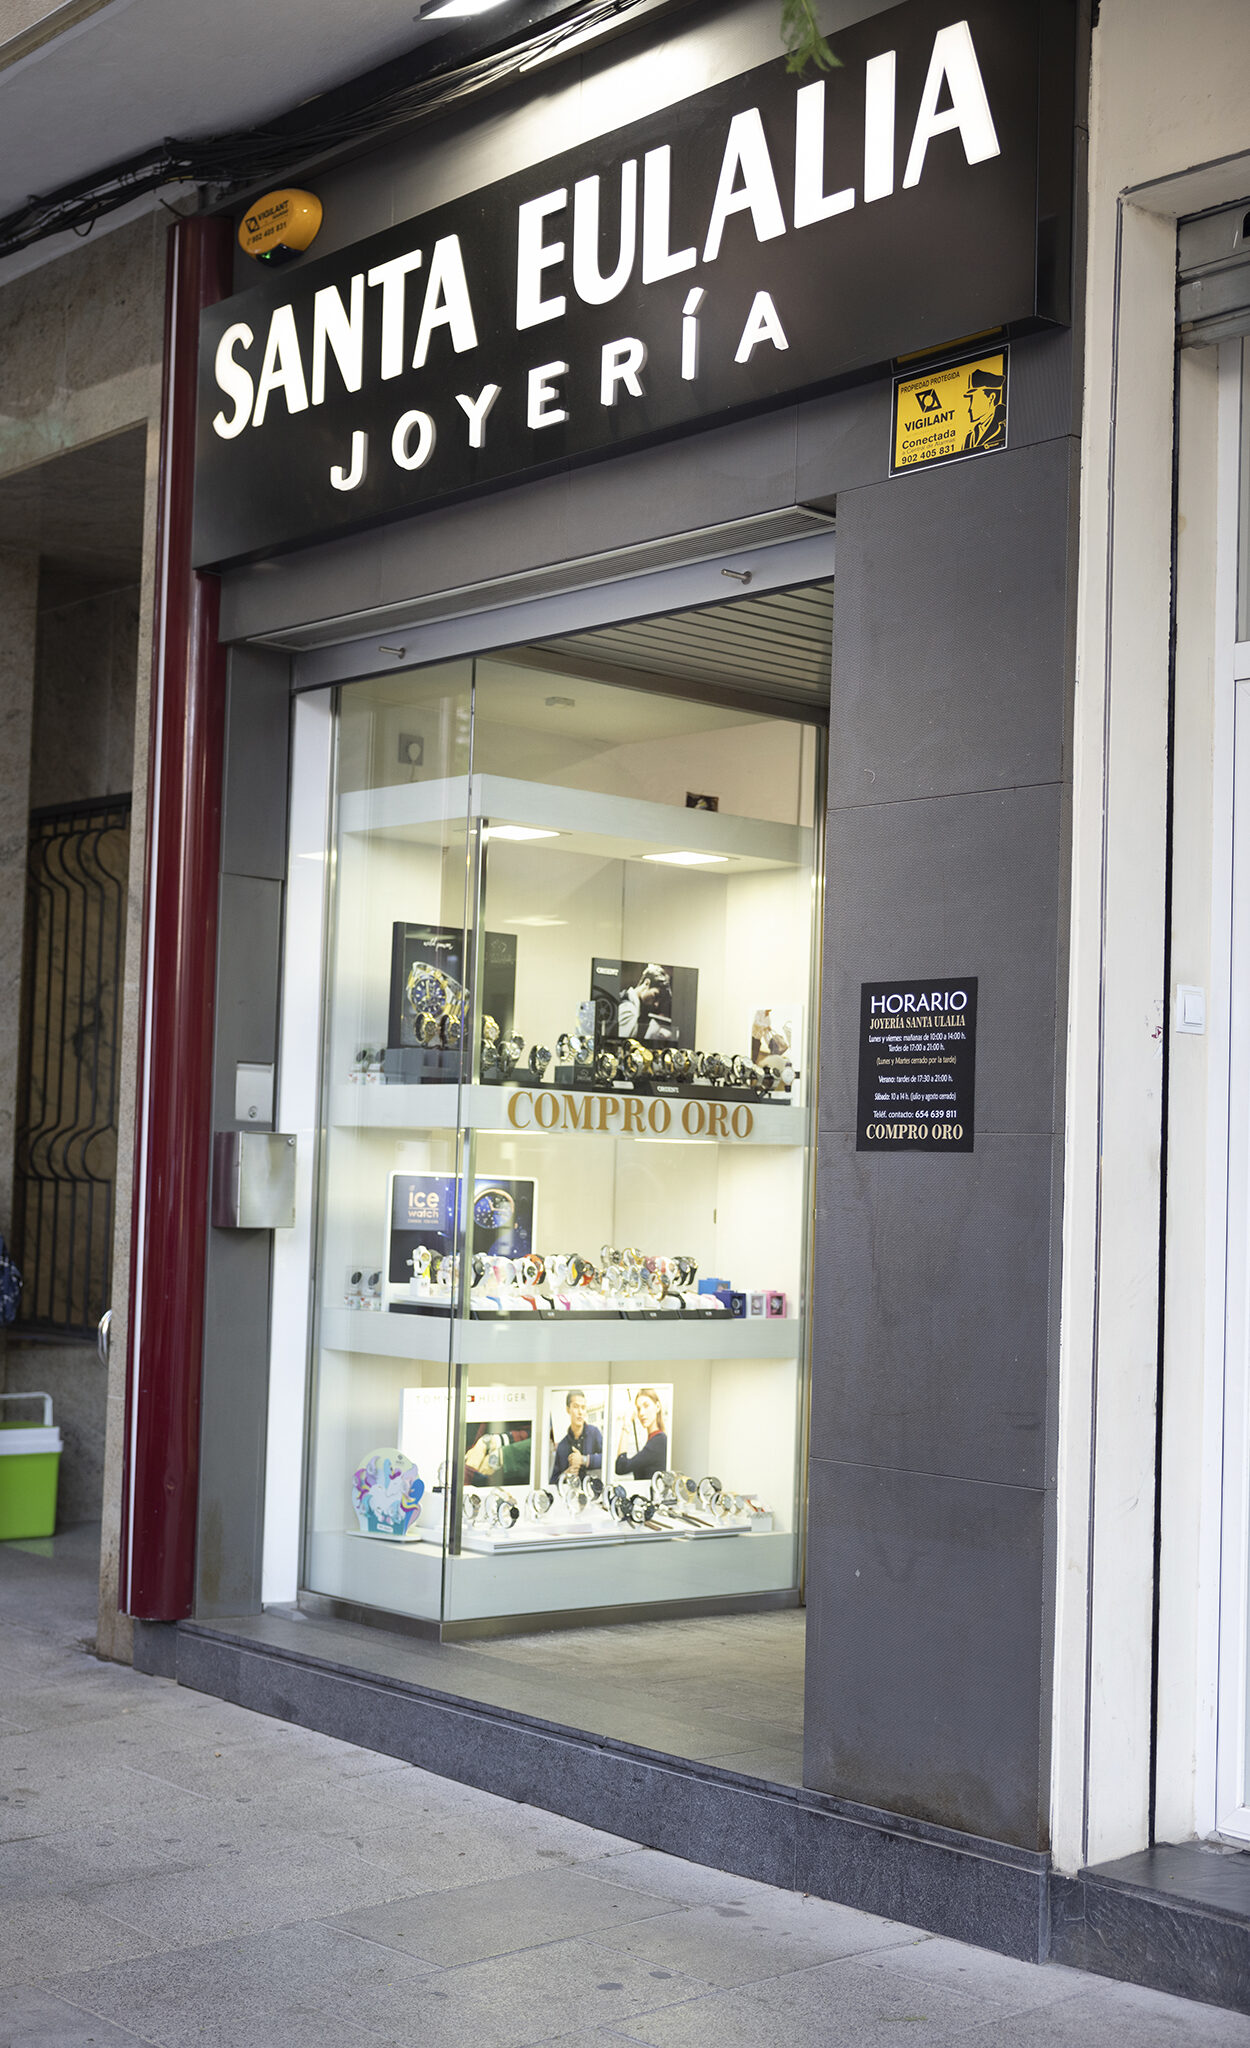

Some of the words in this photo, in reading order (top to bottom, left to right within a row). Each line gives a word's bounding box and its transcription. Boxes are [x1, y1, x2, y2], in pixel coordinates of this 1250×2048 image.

[258, 200, 289, 221] VIGILANT
[212, 233, 479, 441] SANTA
[515, 19, 1002, 331] EULALIA
[330, 286, 790, 493] JOYERÍA
[900, 379, 930, 394] PROPIEDAD
[930, 371, 961, 386] PROTEGIDA
[904, 409, 956, 432] VIGILANT
[901, 428, 957, 450] Conectada
[901, 453, 918, 465] 902
[919, 448, 937, 460] 405
[938, 444, 955, 456] 831
[870, 990, 968, 1014] HORARIO
[869, 1014, 905, 1030] JOYERÍA
[905, 1015, 933, 1029] SANTA
[934, 1014, 966, 1028] ULALIA
[868, 1035, 881, 1043] Lunes
[903, 1033, 923, 1042] mañanas
[923, 1033, 929, 1041] de
[929, 1032, 943, 1040] 10:00
[947, 1032, 961, 1040] 14:00
[888, 1044, 902, 1052] Tardes
[909, 1043, 923, 1051] 17:00
[926, 1043, 940, 1051] 21:00
[895, 1056, 910, 1064] Martes
[911, 1056, 928, 1064] cerrado
[928, 1057, 937, 1066] por
[943, 1055, 957, 1065] tarde)
[896, 1075, 910, 1083] tardes
[934, 1074, 948, 1082] 21:00
[891, 1092, 897, 1100] 10
[900, 1092, 905, 1100] 14
[925, 1093, 938, 1102] agosto
[507, 1090, 671, 1135] COMPRO
[681, 1100, 754, 1139] ORO
[915, 1110, 929, 1118] 654
[930, 1110, 944, 1118] 639
[945, 1110, 957, 1118] 811
[866, 1123, 929, 1140] COMPRO
[931, 1123, 964, 1140] ORO
[408, 1185, 440, 1208] ice
[408, 1209, 439, 1218] watch
